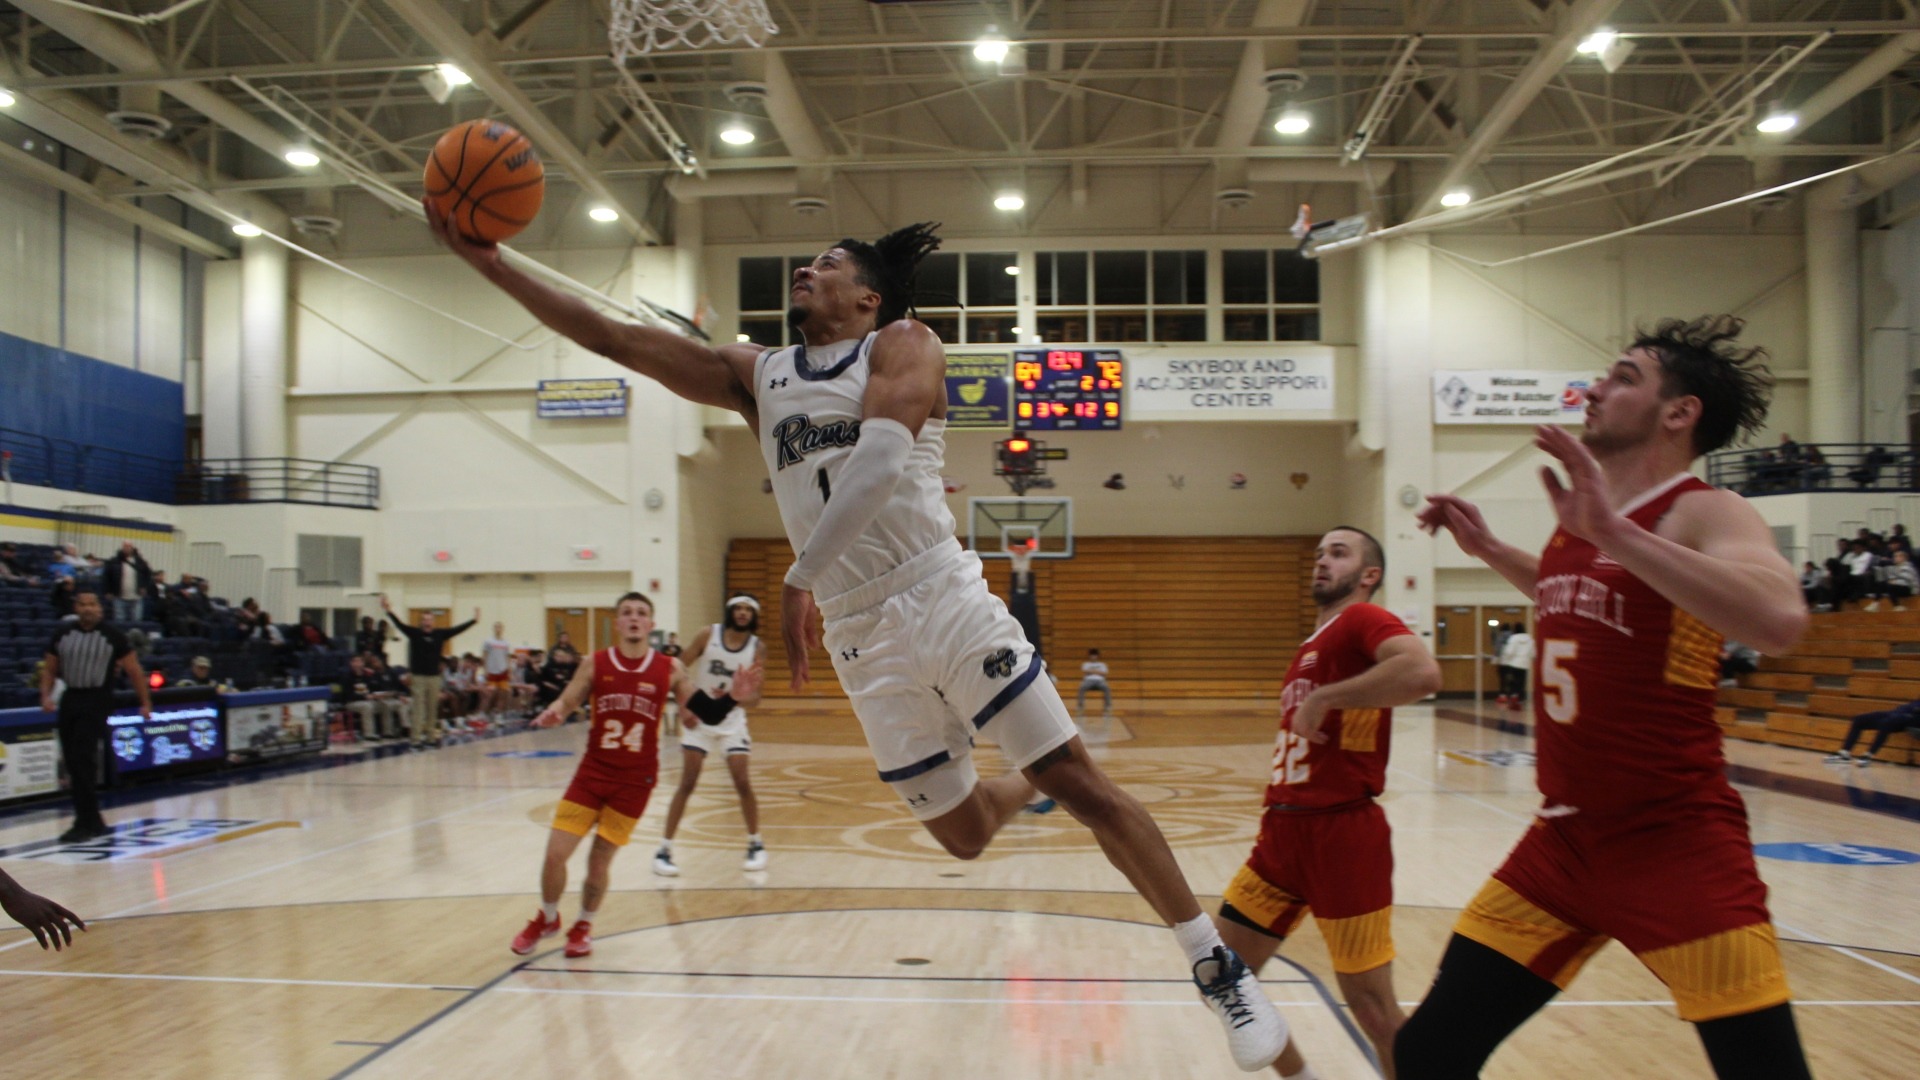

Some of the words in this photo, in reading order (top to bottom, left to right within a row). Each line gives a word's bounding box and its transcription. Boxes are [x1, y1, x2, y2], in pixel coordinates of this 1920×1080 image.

[1168, 359, 1247, 374] SKYBOX
[1252, 359, 1296, 373] AND
[1080, 375, 1094, 391] 2
[1490, 377, 1539, 387] Welcome
[1191, 393, 1274, 407] CENTER
[1476, 393, 1488, 401] to
[1492, 392, 1509, 401] the
[1513, 392, 1555, 401] Butcher
[1473, 407, 1515, 417] Athletic
[773, 413, 861, 472] Rams
[818, 467, 831, 505] 1
[1541, 639, 1580, 725] 5
[600, 719, 646, 753] 24
[1271, 730, 1311, 787] 22
